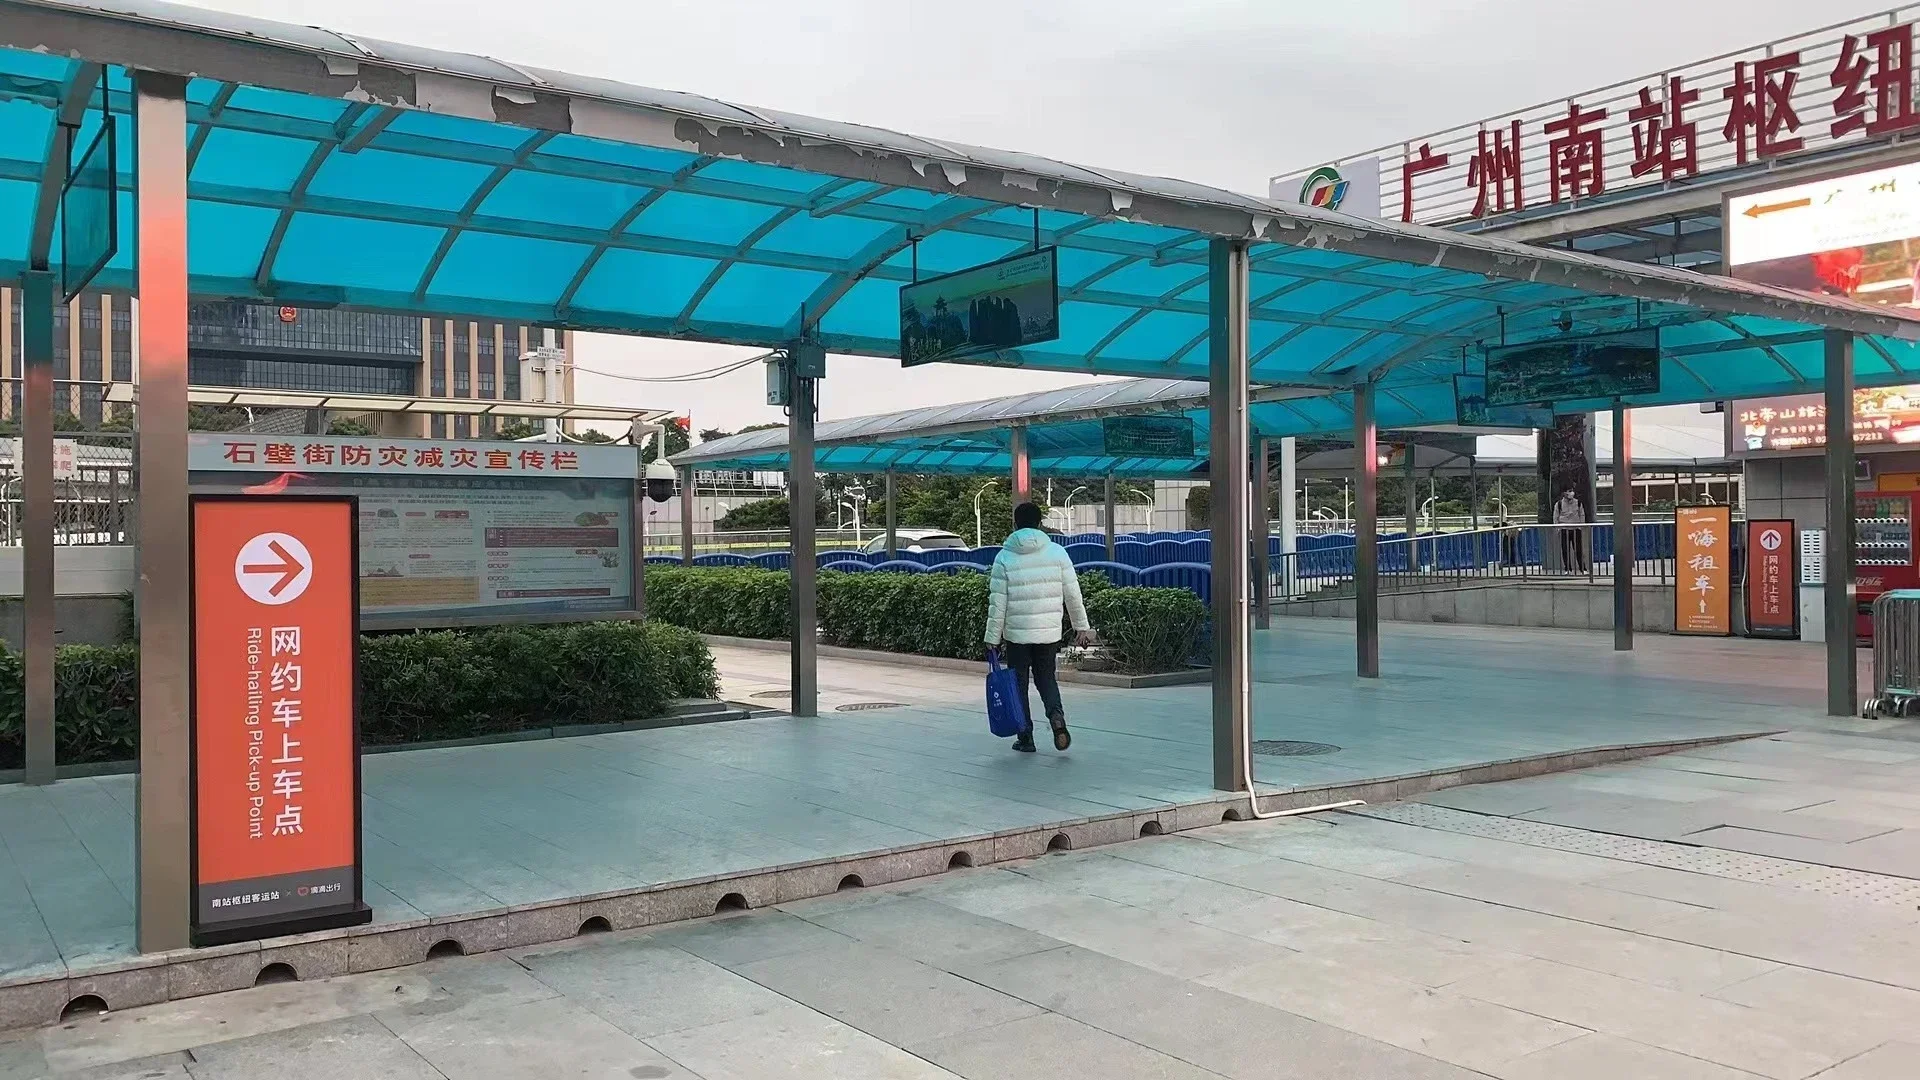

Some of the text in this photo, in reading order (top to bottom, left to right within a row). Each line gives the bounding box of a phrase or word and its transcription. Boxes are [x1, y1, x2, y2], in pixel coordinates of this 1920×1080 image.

[1401, 23, 1920, 223] 广州南站枢纽
[223, 442, 579, 471] 石壁街防灾减灾宣传栏
[1687, 517, 1720, 597] 一嗨租车
[1769, 555, 1779, 614] 网约车上车点
[245, 627, 264, 839] Ride-hailing Pick-up Point
[271, 626, 304, 836] 网约车上车点
[212, 890, 280, 908] 南站枢纽客运站
[310, 883, 341, 895] 滴滴出行
